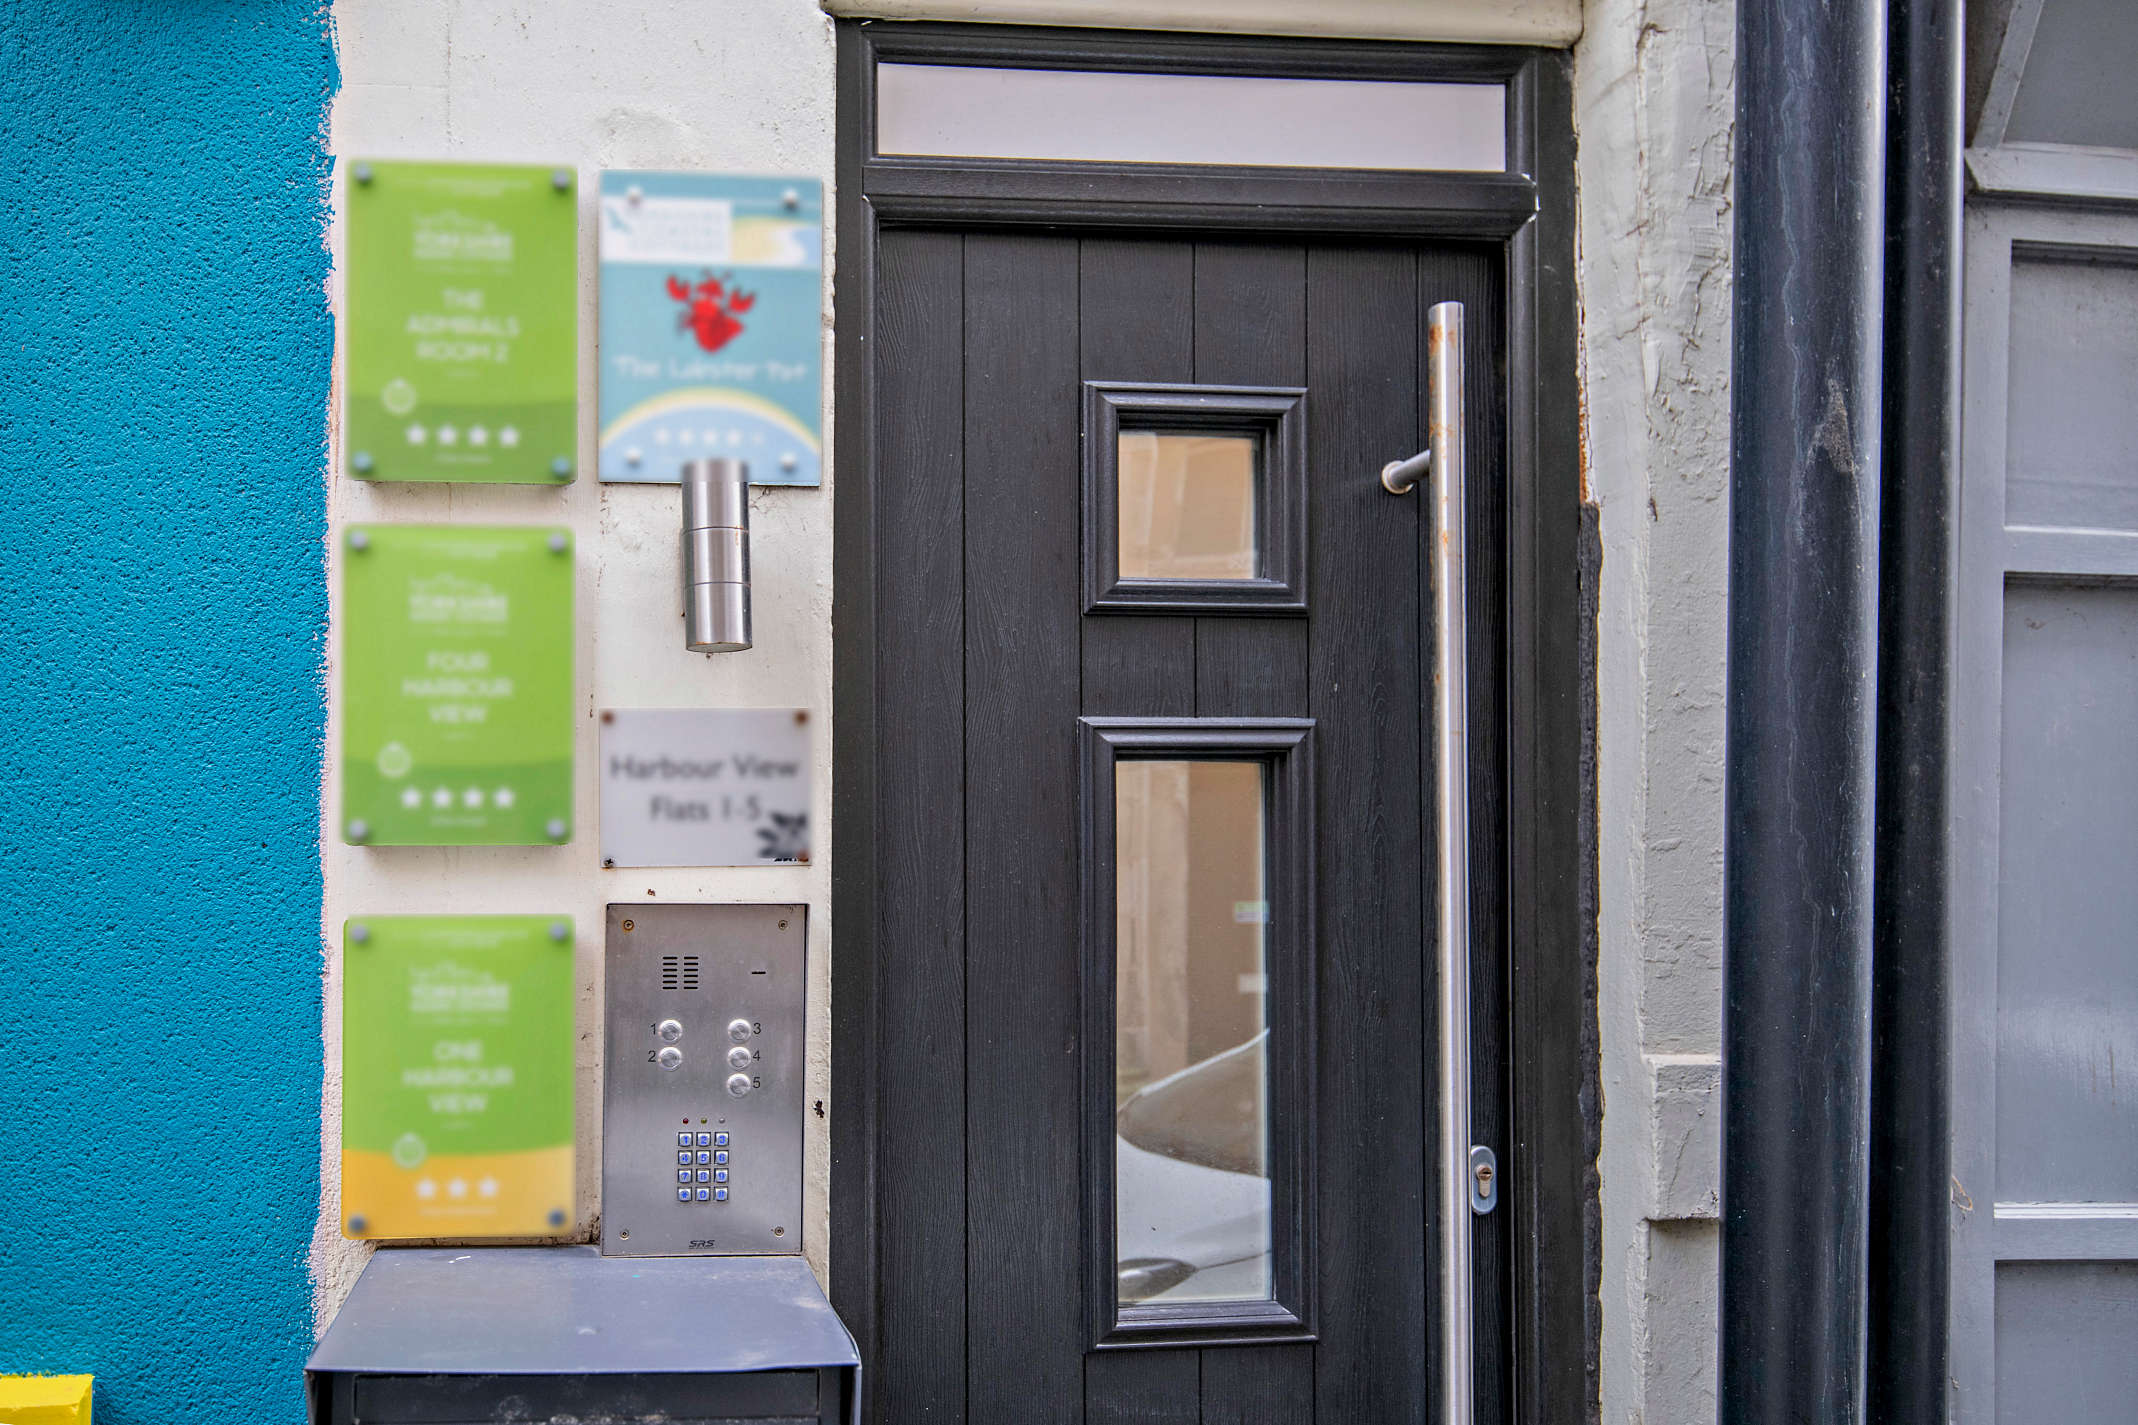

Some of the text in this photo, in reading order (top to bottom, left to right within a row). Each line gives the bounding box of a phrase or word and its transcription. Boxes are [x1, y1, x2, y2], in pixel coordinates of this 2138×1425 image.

[443, 289, 482, 310] THE
[427, 653, 489, 672] FOUR
[402, 678, 512, 698] HARBOUR
[429, 705, 487, 723] VIEW
[610, 753, 799, 779] Harbour View
[650, 796, 709, 821] Flats
[650, 1022, 762, 1035] 1 3
[433, 1041, 483, 1062] ONE
[648, 1050, 761, 1063] 2 4
[403, 1067, 513, 1087] HARBOUR
[752, 1077, 761, 1089] 5
[429, 1095, 487, 1114] VIEW
